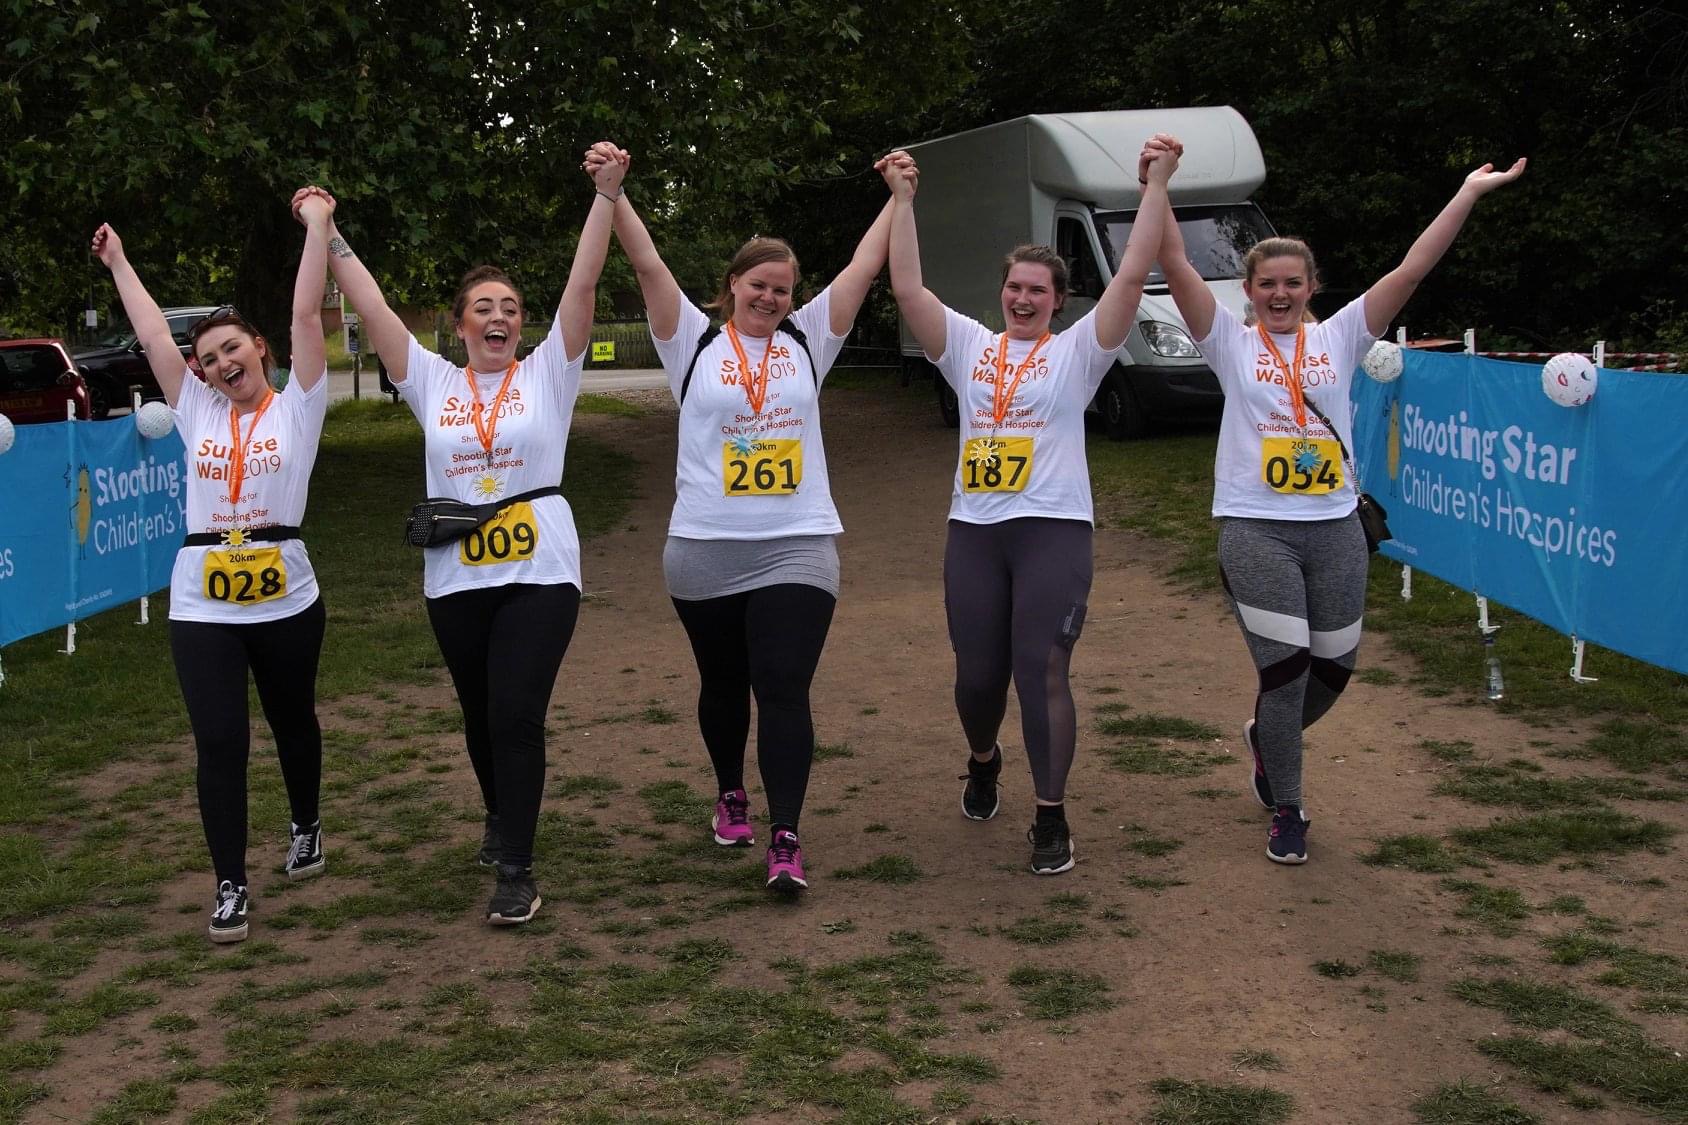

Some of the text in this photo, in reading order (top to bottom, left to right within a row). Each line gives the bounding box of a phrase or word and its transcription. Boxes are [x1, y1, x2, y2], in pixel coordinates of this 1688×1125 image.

[766, 418, 803, 431] Hospices
[774, 407, 792, 417] Star
[1015, 408, 1033, 417] Star
[1257, 424, 1300, 435] Children's
[495, 447, 513, 456] Star
[1291, 441, 1318, 450] 20m
[1403, 403, 1499, 480] Shooting
[1502, 425, 1577, 485] Star
[95, 455, 180, 507] Shooting
[196, 461, 230, 481] Wal
[729, 458, 798, 491] 261
[966, 455, 1027, 489] 187
[1266, 456, 1339, 490] 054
[252, 509, 269, 518] Star
[1402, 463, 1617, 567] Children's Hospices
[94, 503, 176, 555] Children's
[464, 522, 535, 562] 009
[229, 553, 256, 562] 20km
[208, 567, 281, 601] 028
